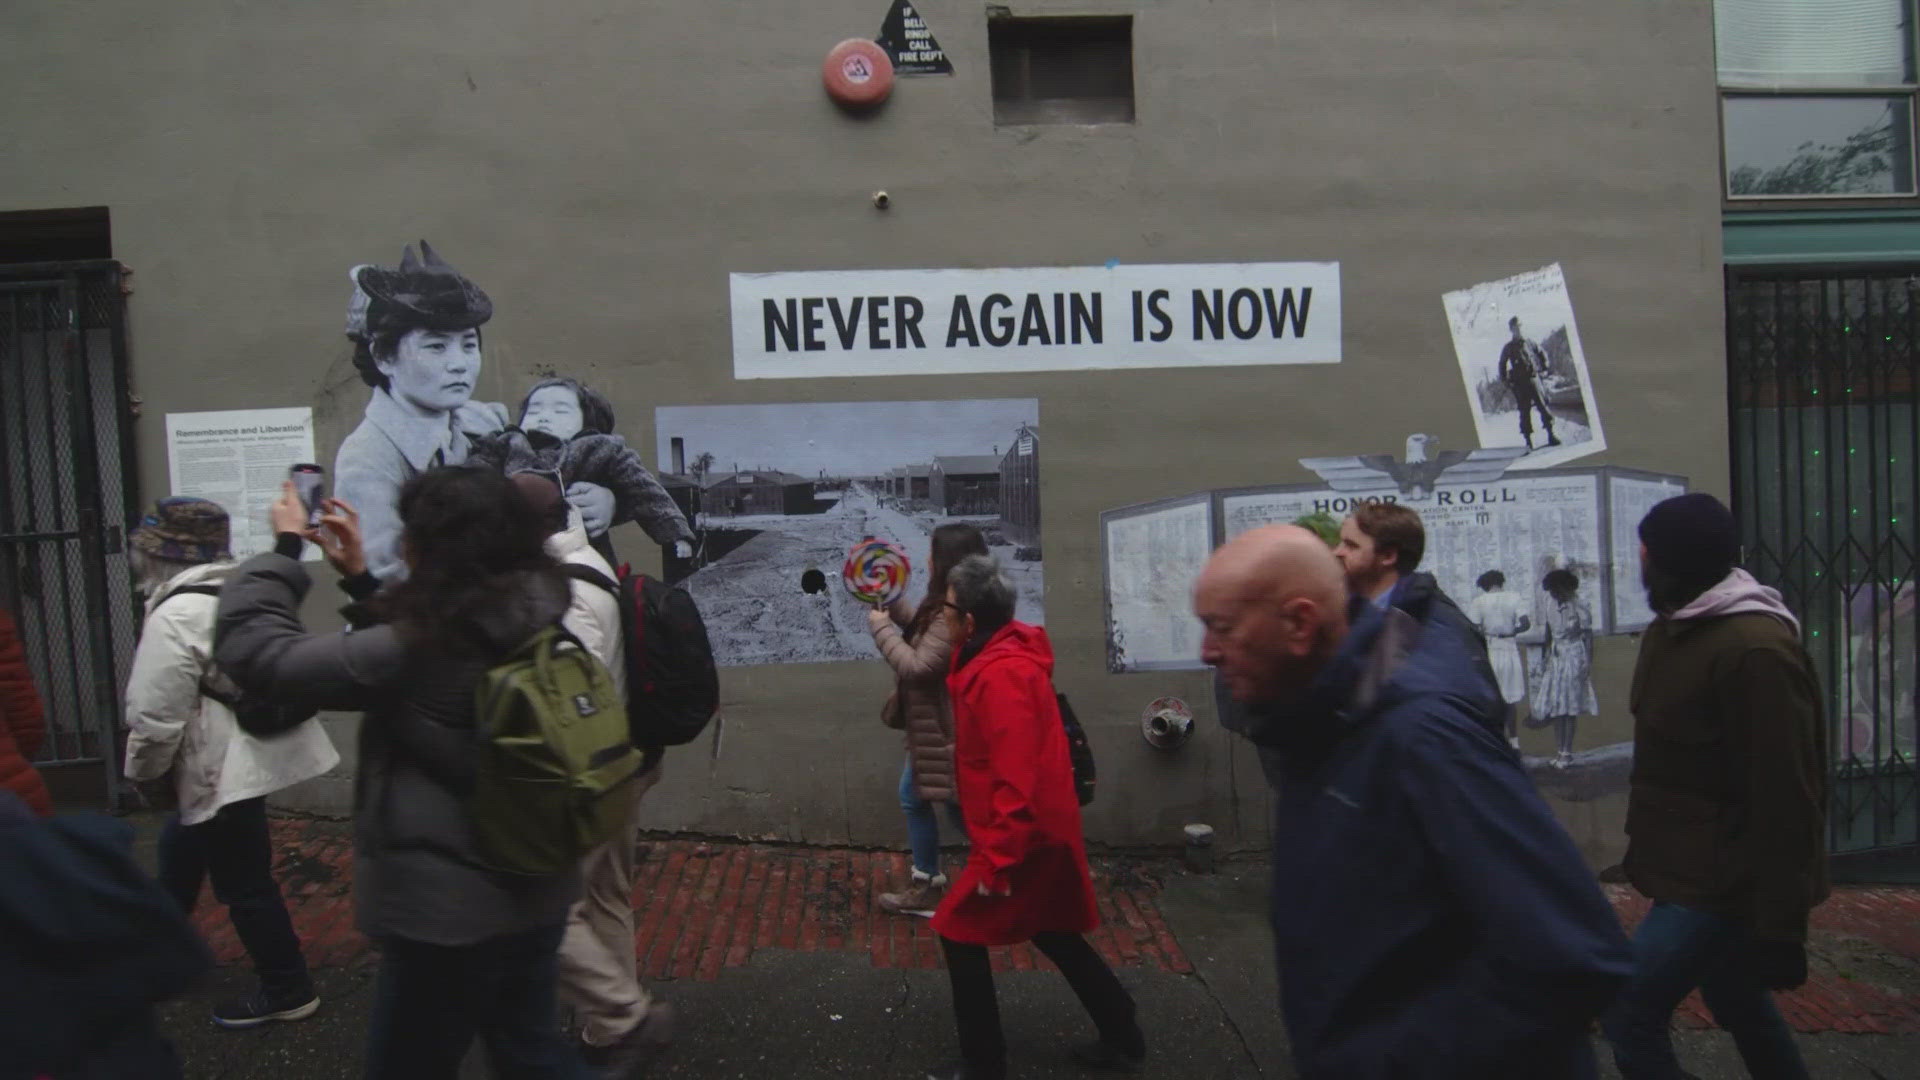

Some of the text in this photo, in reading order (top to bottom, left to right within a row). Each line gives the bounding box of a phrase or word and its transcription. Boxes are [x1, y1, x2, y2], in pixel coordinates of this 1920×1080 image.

[903, 7, 911, 17] IF
[904, 18, 925, 28] BELL
[905, 30, 930, 39] RINGS
[909, 40, 931, 50] CALL
[899, 51, 942, 62] FIRE DEPT
[762, 287, 1313, 352] NEVER AGAIN IS NOW
[176, 424, 304, 438] Remembrance and Liberation
[1313, 495, 1397, 513] HONOR
[1437, 488, 1516, 506] ROLL
